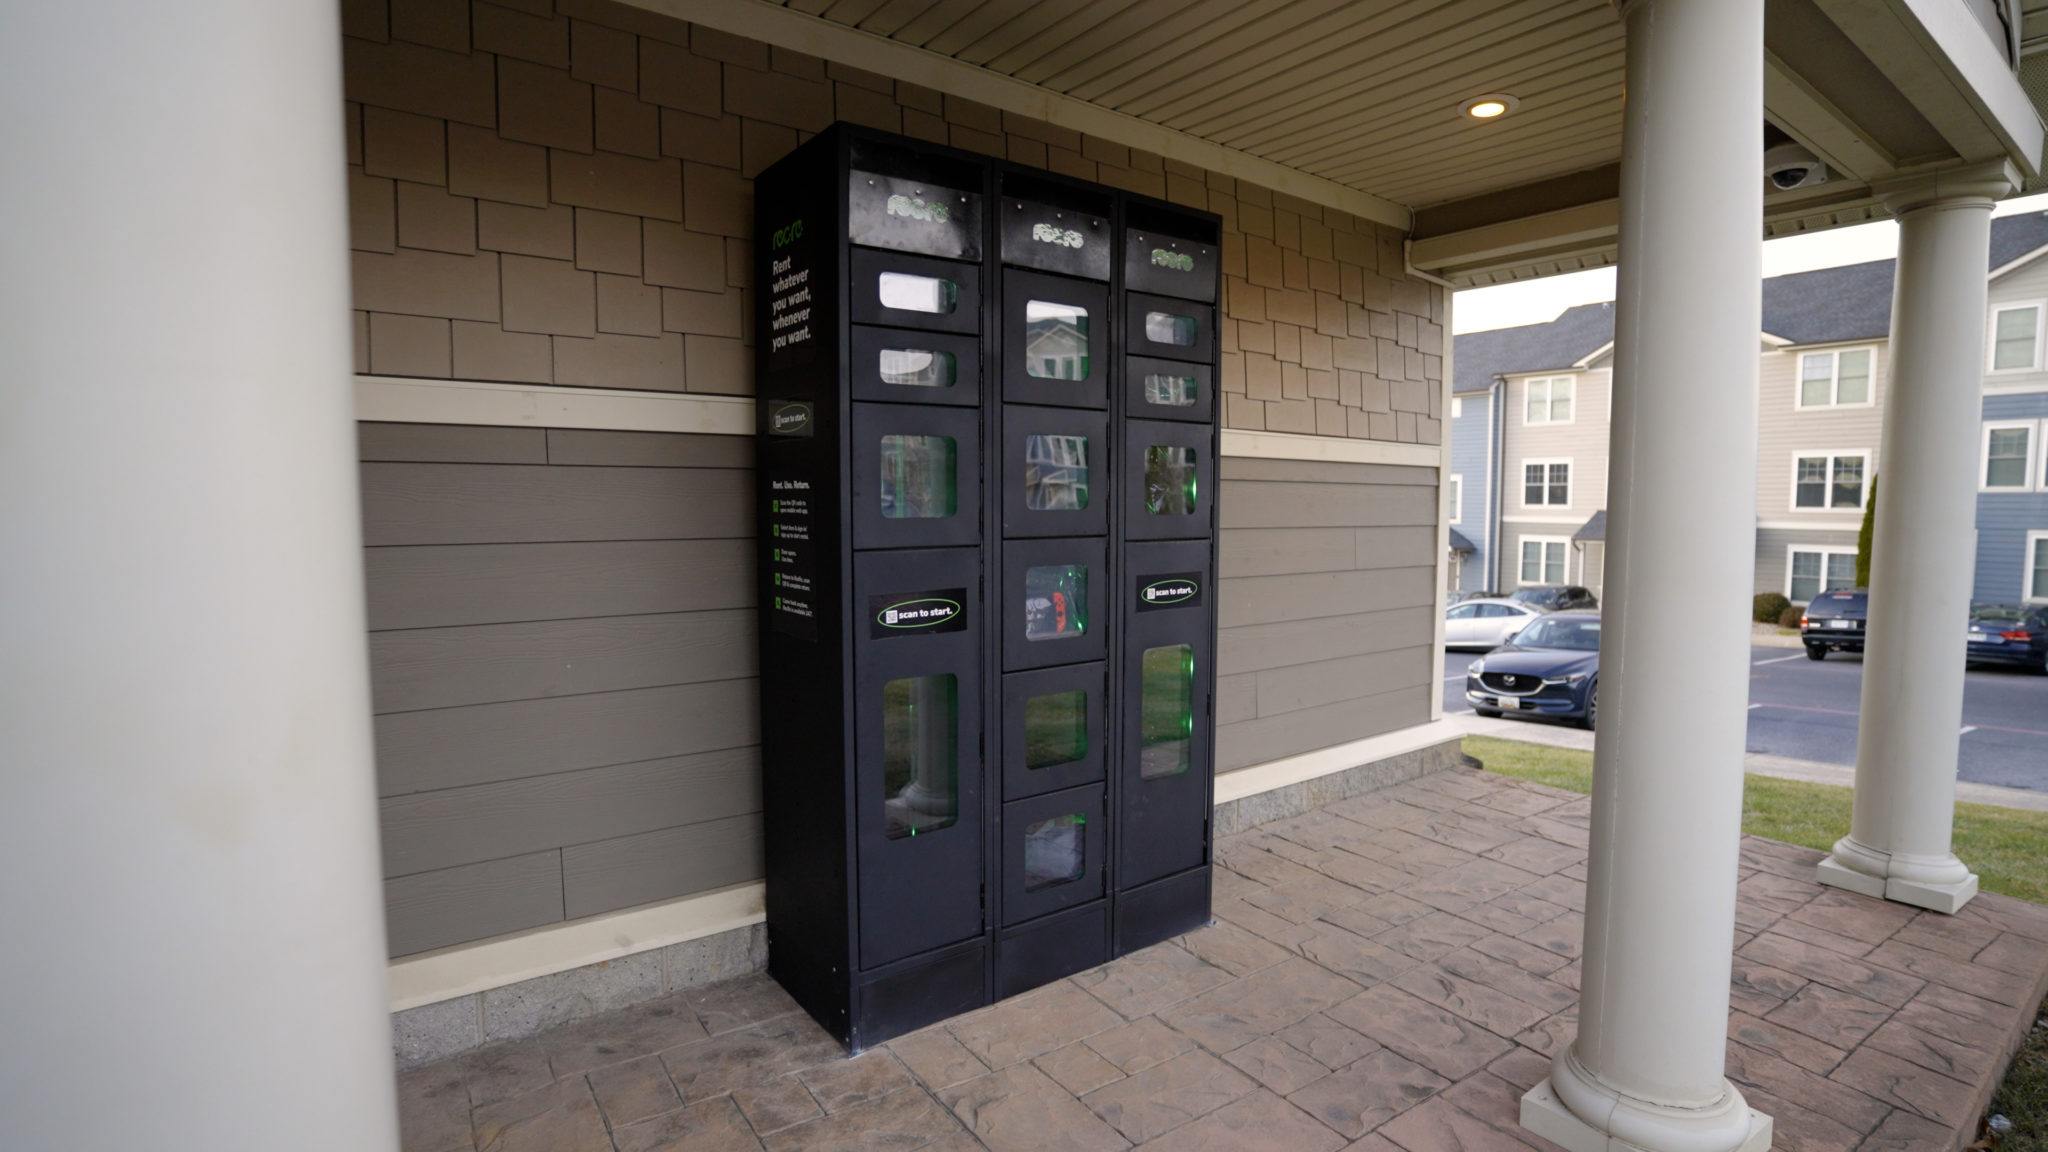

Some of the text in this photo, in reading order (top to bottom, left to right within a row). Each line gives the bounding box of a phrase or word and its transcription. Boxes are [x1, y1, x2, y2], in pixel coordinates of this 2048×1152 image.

[772, 255, 792, 276] Rent
[772, 268, 810, 294] whatever
[772, 285, 812, 317] you want,
[772, 307, 811, 331] whenever
[772, 325, 812, 353] you want.
[1177, 587, 1192, 595] start.
[899, 607, 953, 619] scan to start.
